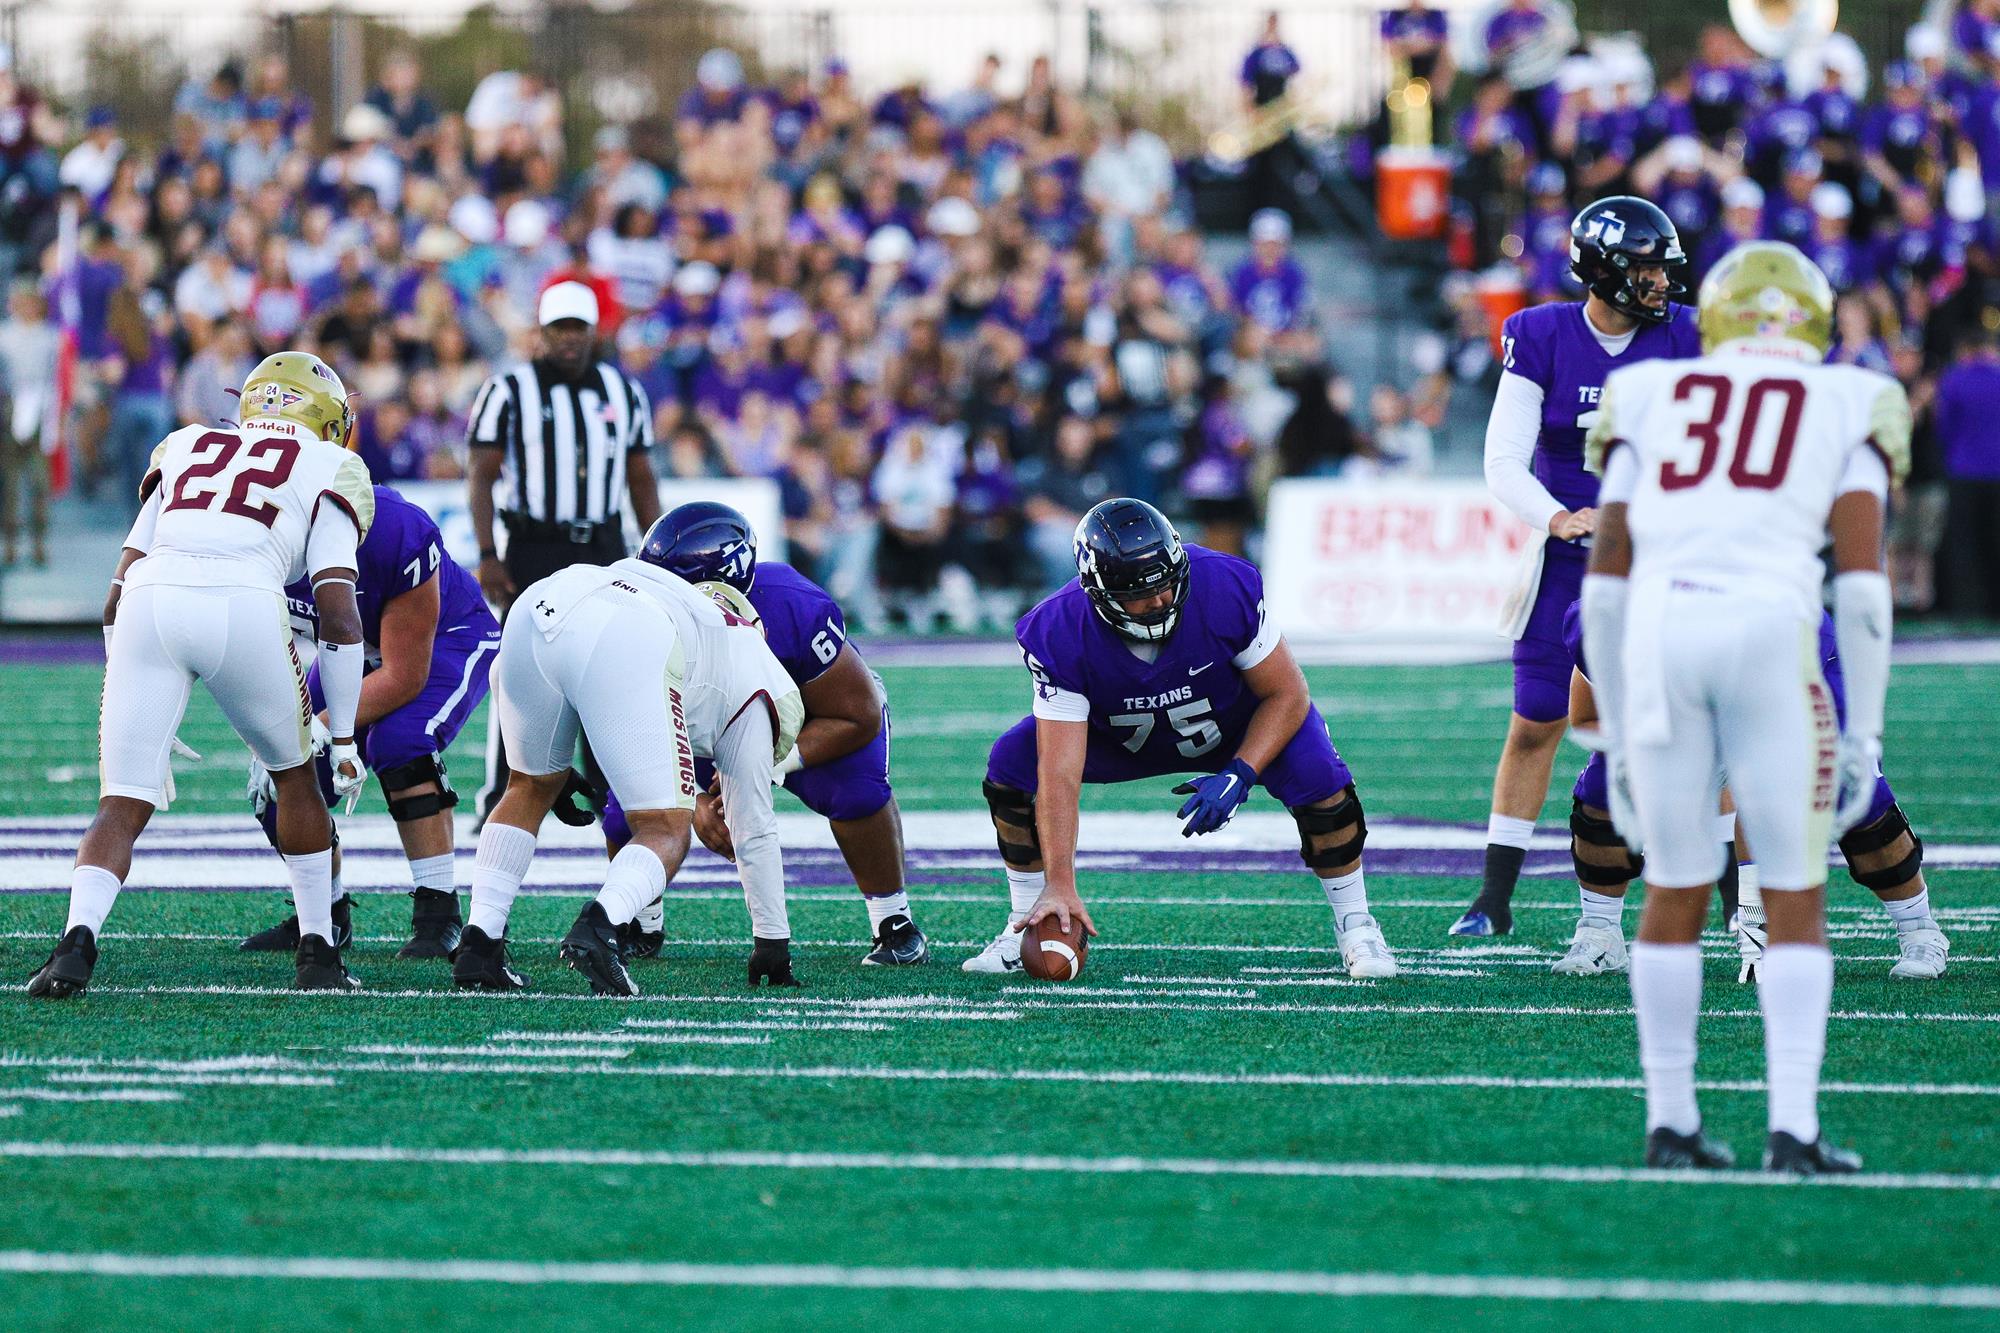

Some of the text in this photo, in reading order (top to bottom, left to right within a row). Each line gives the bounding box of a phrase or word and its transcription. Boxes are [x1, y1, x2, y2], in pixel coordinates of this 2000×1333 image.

[266, 385, 278, 396] 24
[1660, 373, 1807, 491] 30
[163, 431, 301, 530] 22
[403, 541, 441, 589] 74
[811, 616, 846, 665] 61
[1123, 685, 1193, 711] TEXANS
[668, 686, 696, 798] MUSTANGS
[1109, 697, 1223, 759] 75
